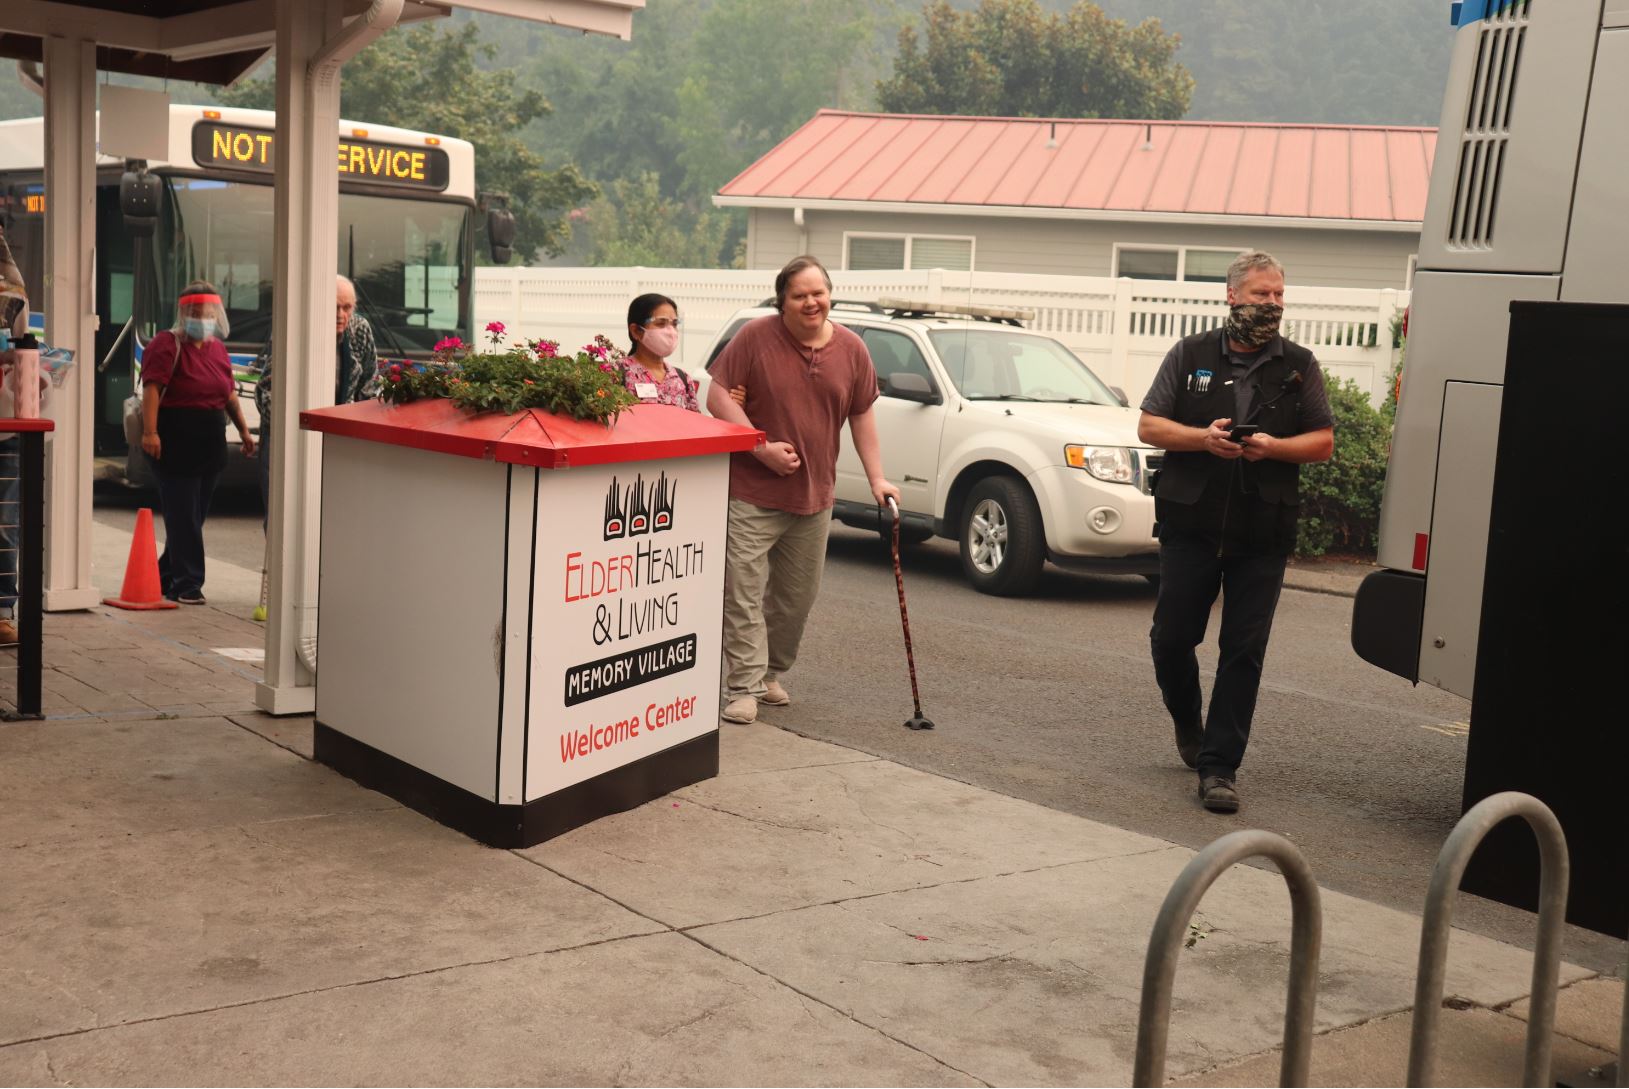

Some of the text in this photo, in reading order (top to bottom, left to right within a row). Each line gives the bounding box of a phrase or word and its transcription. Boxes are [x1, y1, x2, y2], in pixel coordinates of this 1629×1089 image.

[212, 129, 425, 180] NOT ERVICE
[27, 195, 39, 212] NOT
[592, 592, 678, 646] & LIVING
[568, 639, 694, 698] MEMORY VILLAGE
[560, 695, 697, 763] Welcome Center
